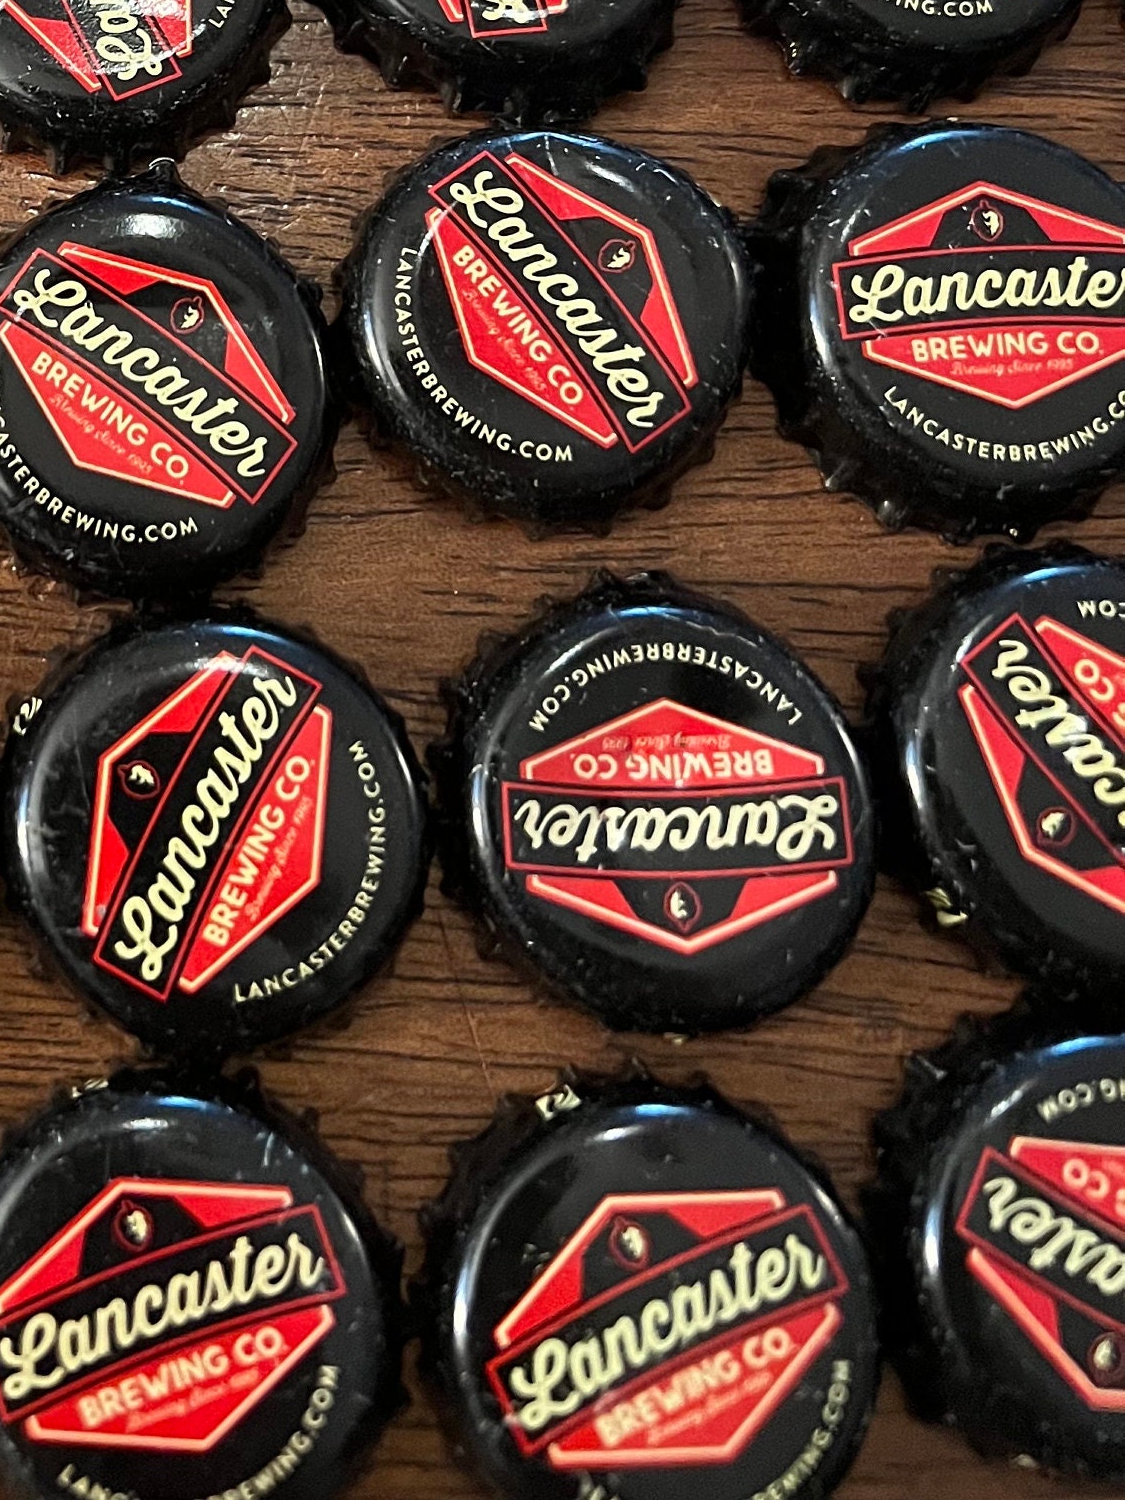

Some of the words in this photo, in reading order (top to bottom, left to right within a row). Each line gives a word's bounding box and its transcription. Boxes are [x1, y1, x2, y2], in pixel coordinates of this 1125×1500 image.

[449, 170, 663, 427] Lancaster
[451, 246, 551, 362] BREWING
[843, 259, 1125, 322] Lancaste
[908, 334, 1048, 362] BREWING
[11, 267, 267, 476] Lancaster
[31, 351, 149, 445] BREWING
[396, 246, 573, 460] LANCASTERBREWING.COM
[530, 642, 806, 732] LANCASTERBREWING.COM
[626, 749, 773, 777] BREWING
[114, 679, 298, 979] Lancaster
[203, 807, 285, 946] BREWING
[233, 743, 386, 1000] LANCASTERBREWING.COM
[515, 795, 841, 859] Lancaster
[77, 1348, 227, 1428] BREWING
[512, 1236, 825, 1428] Lancaster
